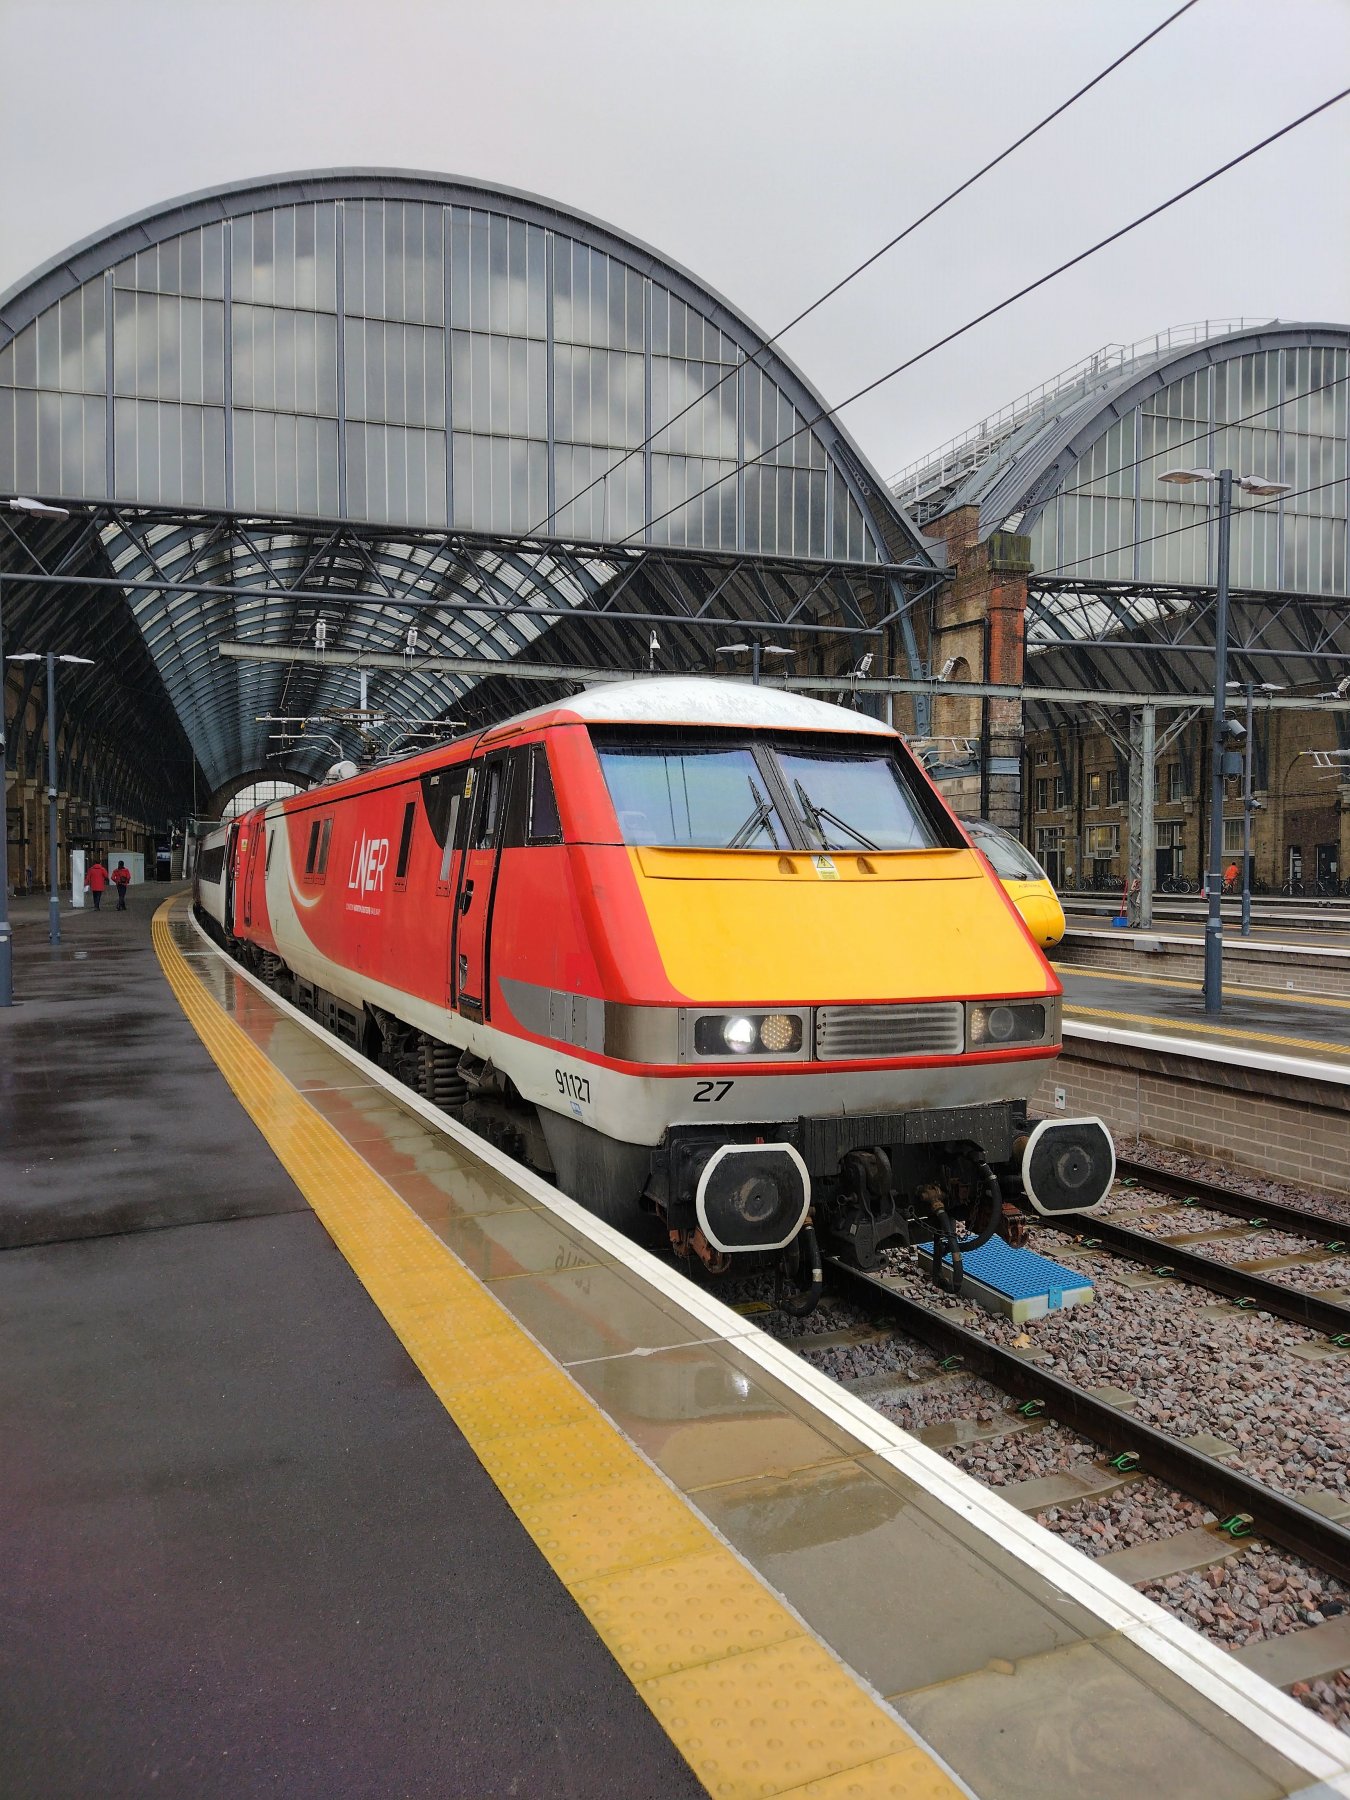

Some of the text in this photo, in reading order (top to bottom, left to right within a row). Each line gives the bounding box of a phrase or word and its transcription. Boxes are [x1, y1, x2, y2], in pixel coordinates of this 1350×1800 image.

[348, 828, 389, 901] LNER
[555, 1068, 591, 1104] 91127
[693, 1081, 735, 1102] 27
